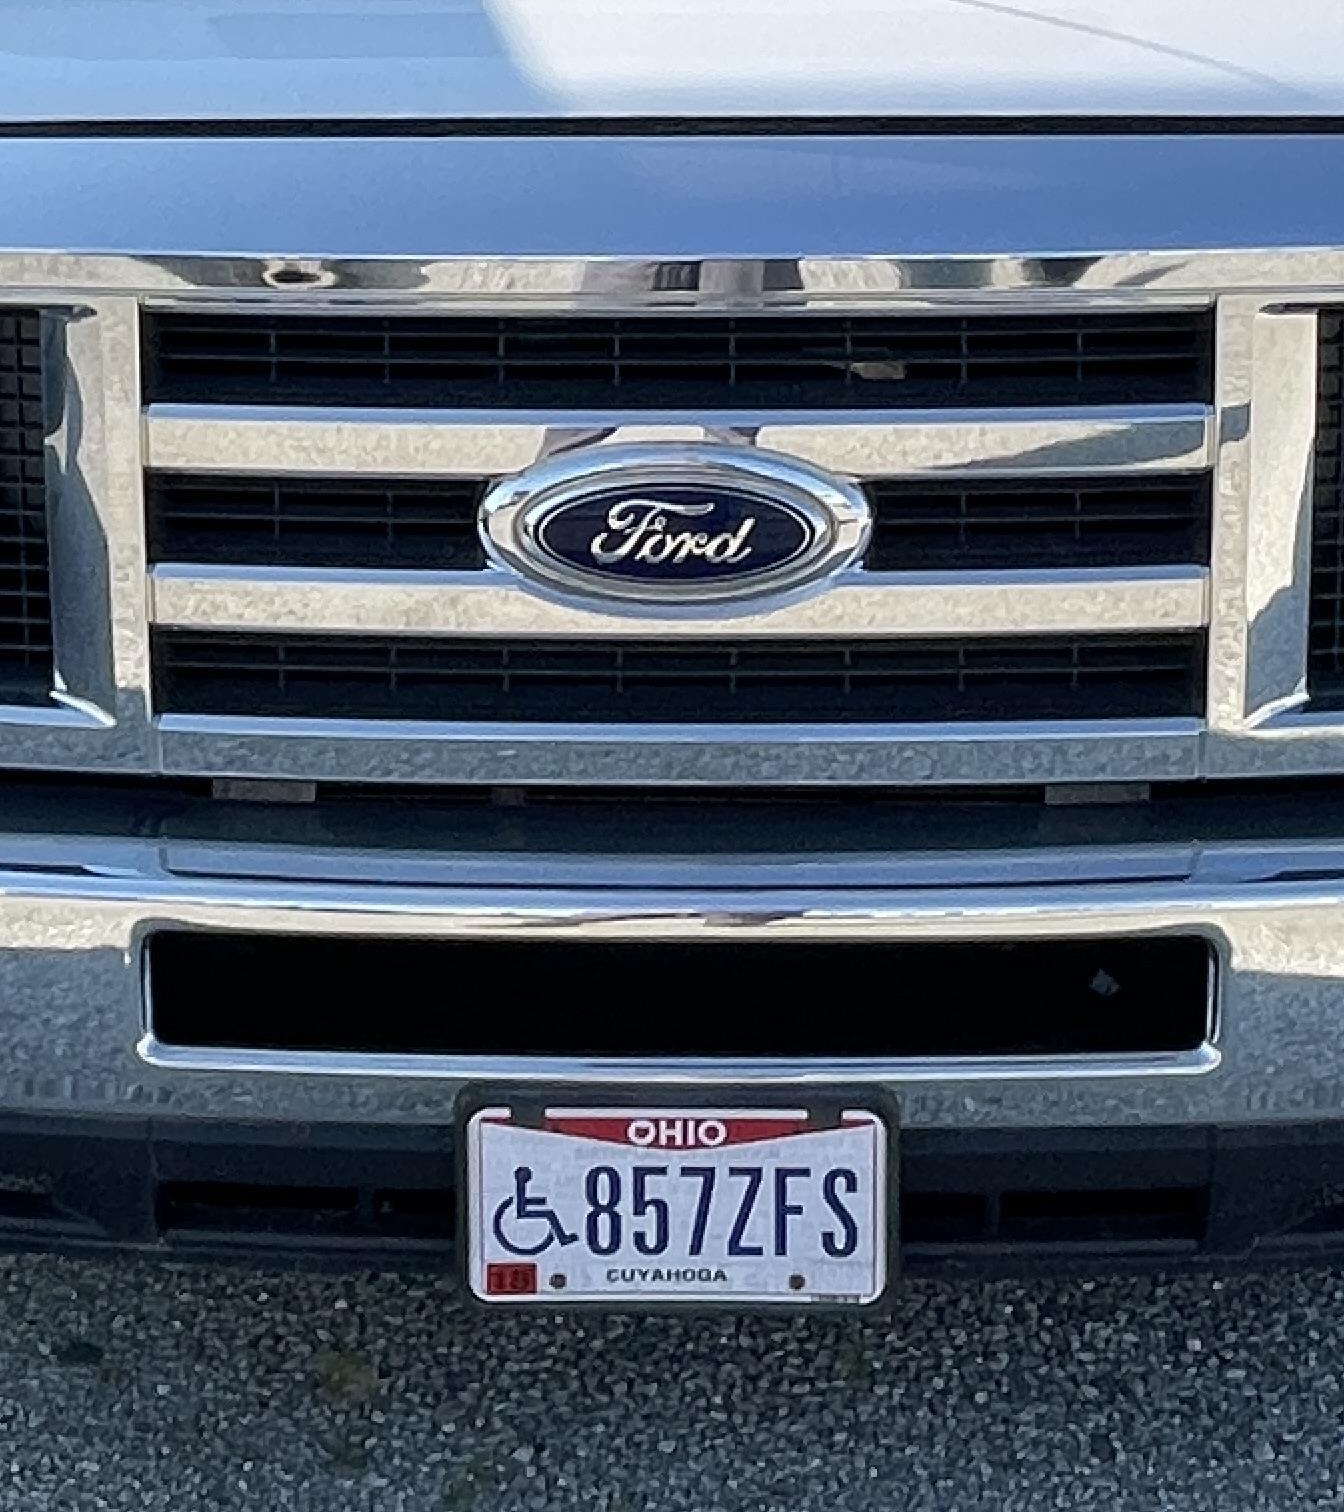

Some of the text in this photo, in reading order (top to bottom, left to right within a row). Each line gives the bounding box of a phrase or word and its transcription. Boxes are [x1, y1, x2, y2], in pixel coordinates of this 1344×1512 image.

[590, 498, 757, 565] Ford
[626, 1119, 728, 1148] OHIO
[584, 1165, 859, 1258] 857ZFS
[605, 1267, 729, 1284] CUYAHOGA
